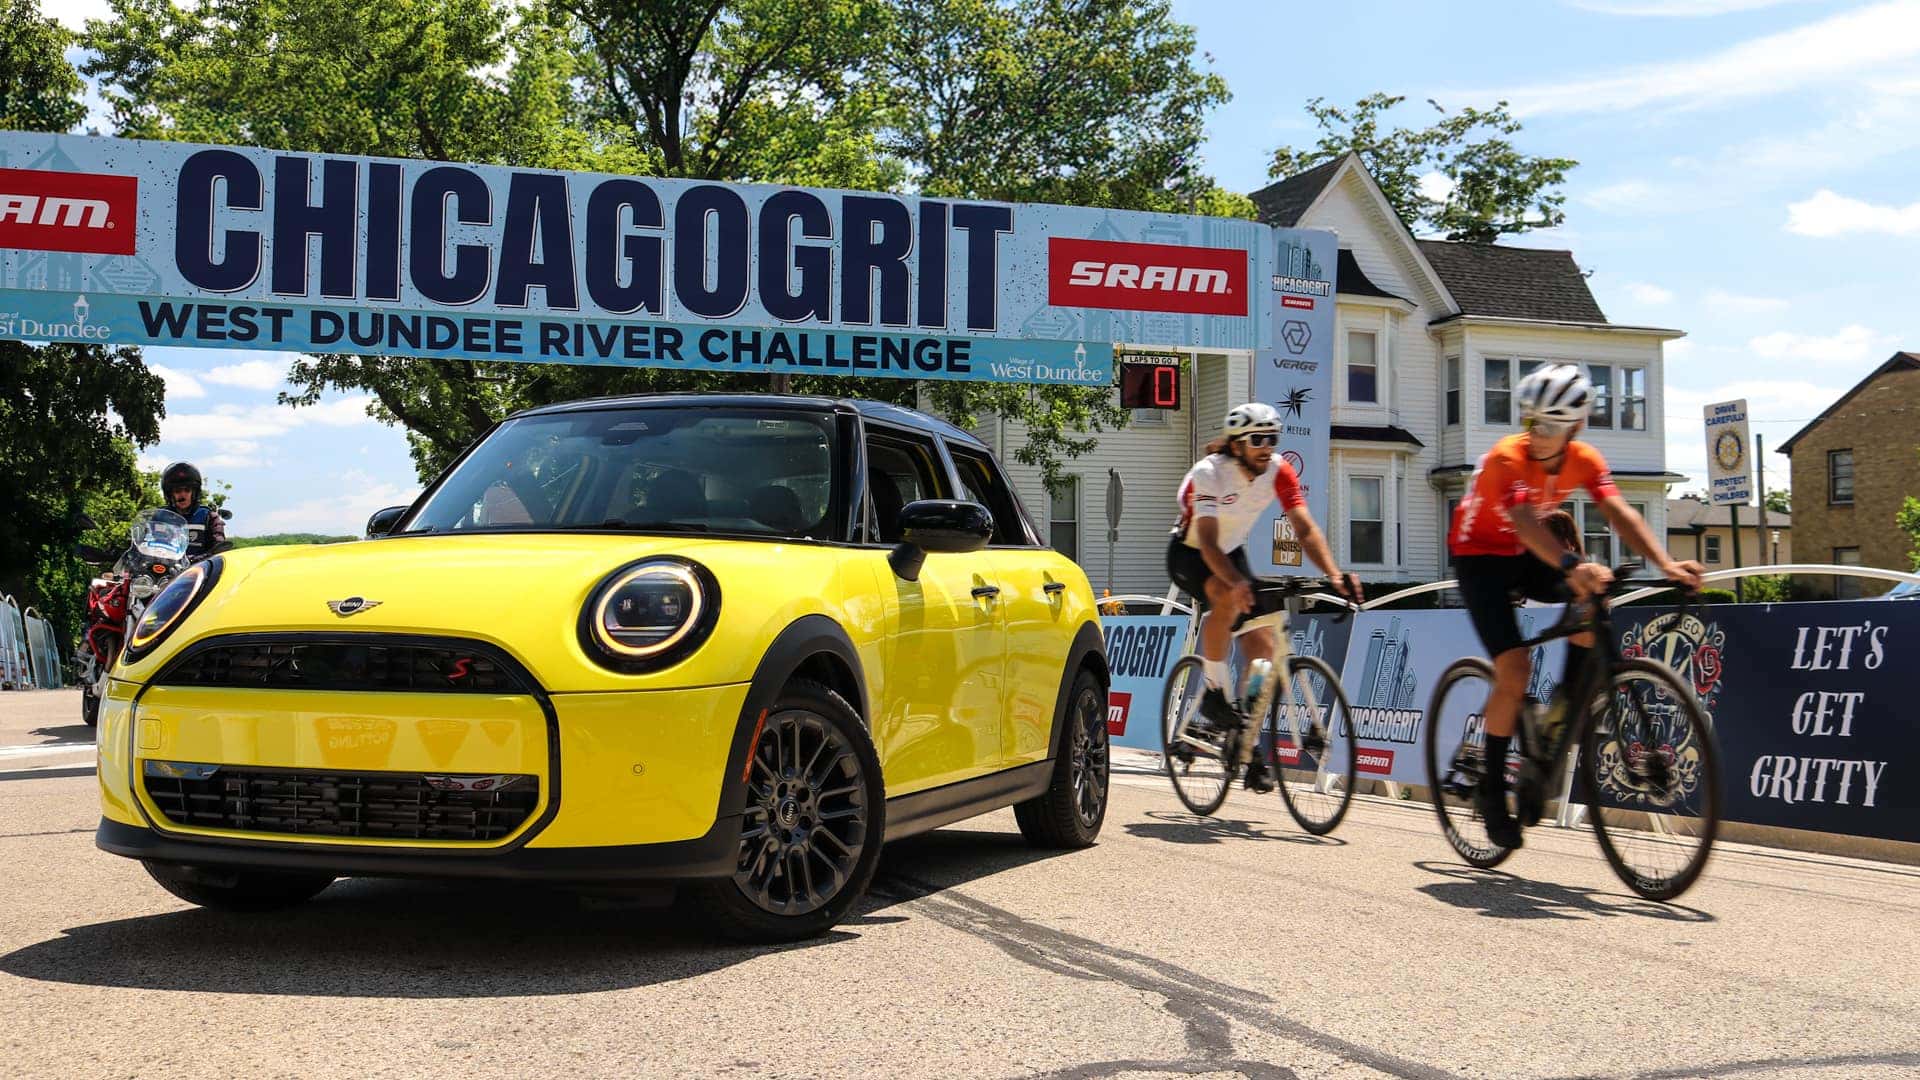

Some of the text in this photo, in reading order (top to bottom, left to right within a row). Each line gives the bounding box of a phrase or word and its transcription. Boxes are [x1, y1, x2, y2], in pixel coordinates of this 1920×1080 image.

[0, 194, 109, 228] AM
[175, 149, 1013, 332] CHICAGOGRIT
[1069, 261, 1230, 294] SRAM
[1272, 275, 1331, 297] HICAGOGRIT
[0, 319, 111, 339] st Dundee
[138, 301, 971, 373] WEST DUNDEE RIVER CHALLENGE
[990, 361, 1103, 381] West Dundee
[1155, 366, 1176, 406] 0
[1715, 405, 1736, 415] DRIVE
[1286, 424, 1311, 436] METEOR
[1714, 477, 1746, 487] PROTECT
[1714, 492, 1749, 501] CHILDREN
[1280, 551, 1296, 563] CUP
[1791, 620, 1888, 672] LET'S
[448, 658, 473, 679] S
[1791, 691, 1864, 737] GET
[1356, 754, 1390, 768] SRAM
[1751, 755, 1888, 807] GRITTY
